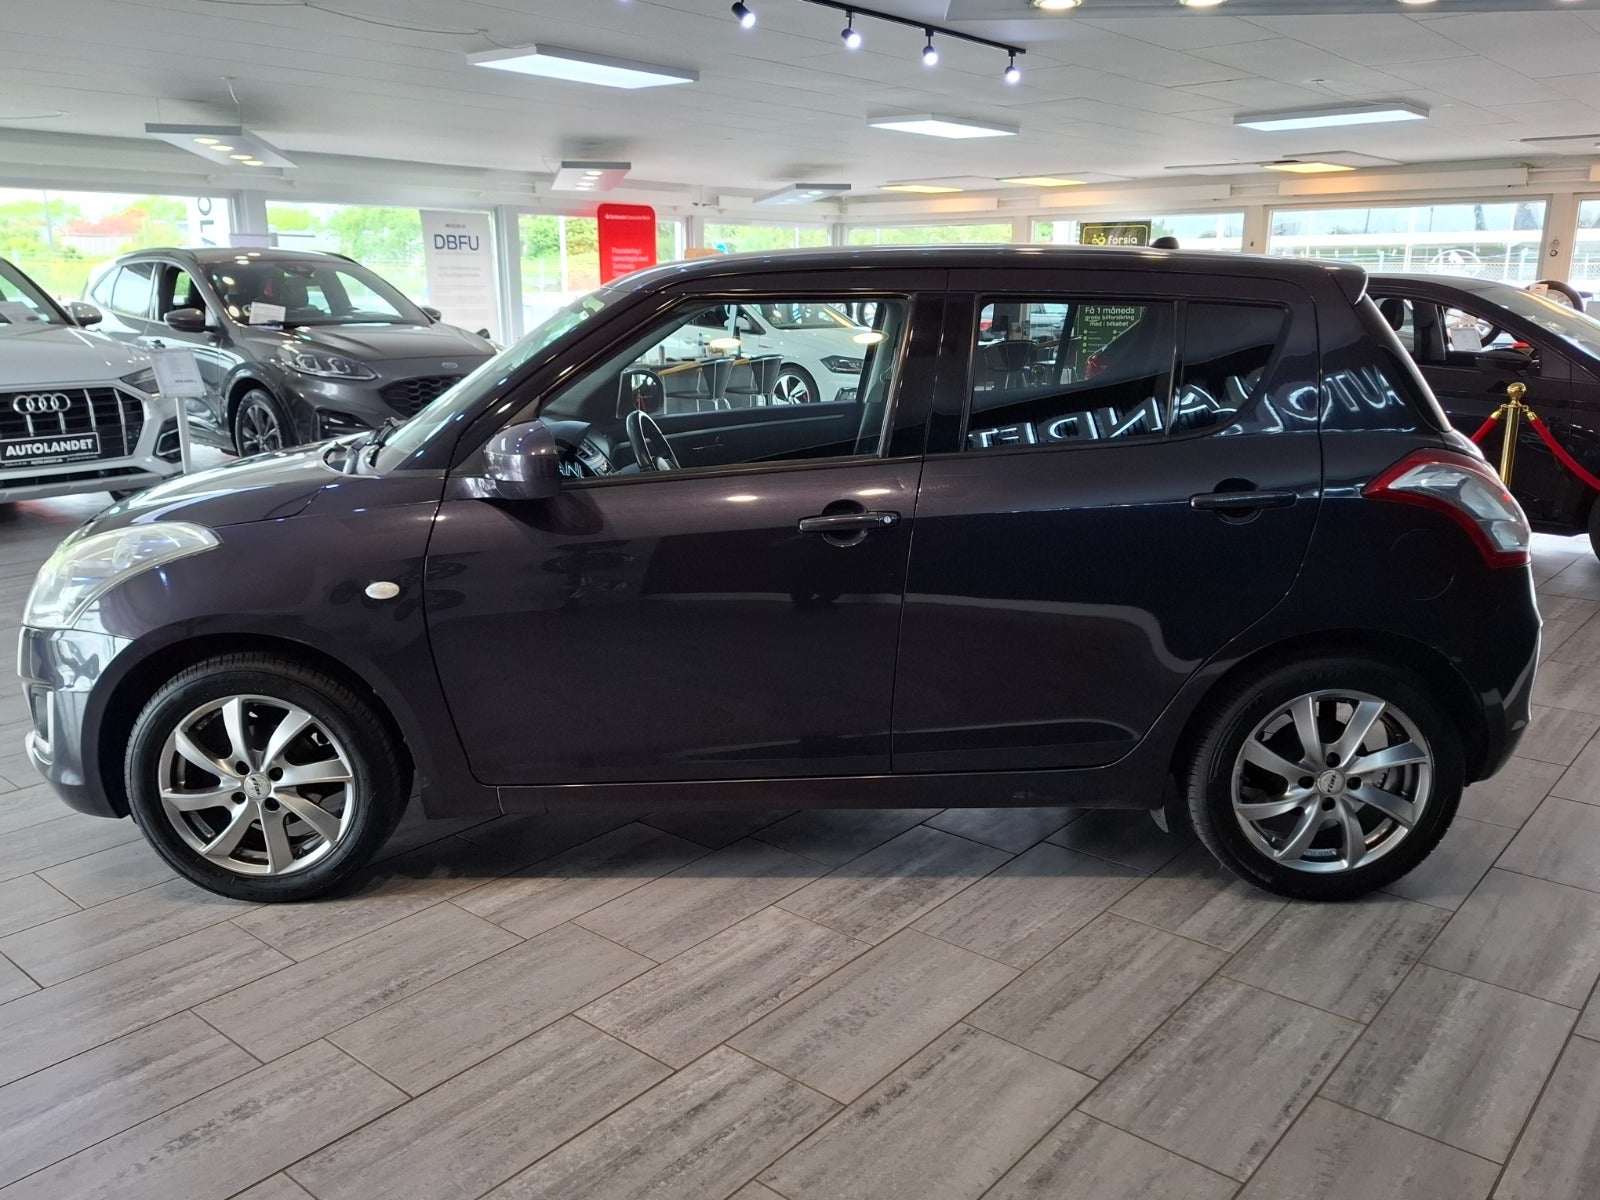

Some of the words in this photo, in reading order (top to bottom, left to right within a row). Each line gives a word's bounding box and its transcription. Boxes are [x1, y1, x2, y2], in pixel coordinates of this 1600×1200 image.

[434, 234, 479, 251] DBFU
[1103, 306, 1135, 314] måneds
[6, 439, 94, 456] AUTOLANDET
